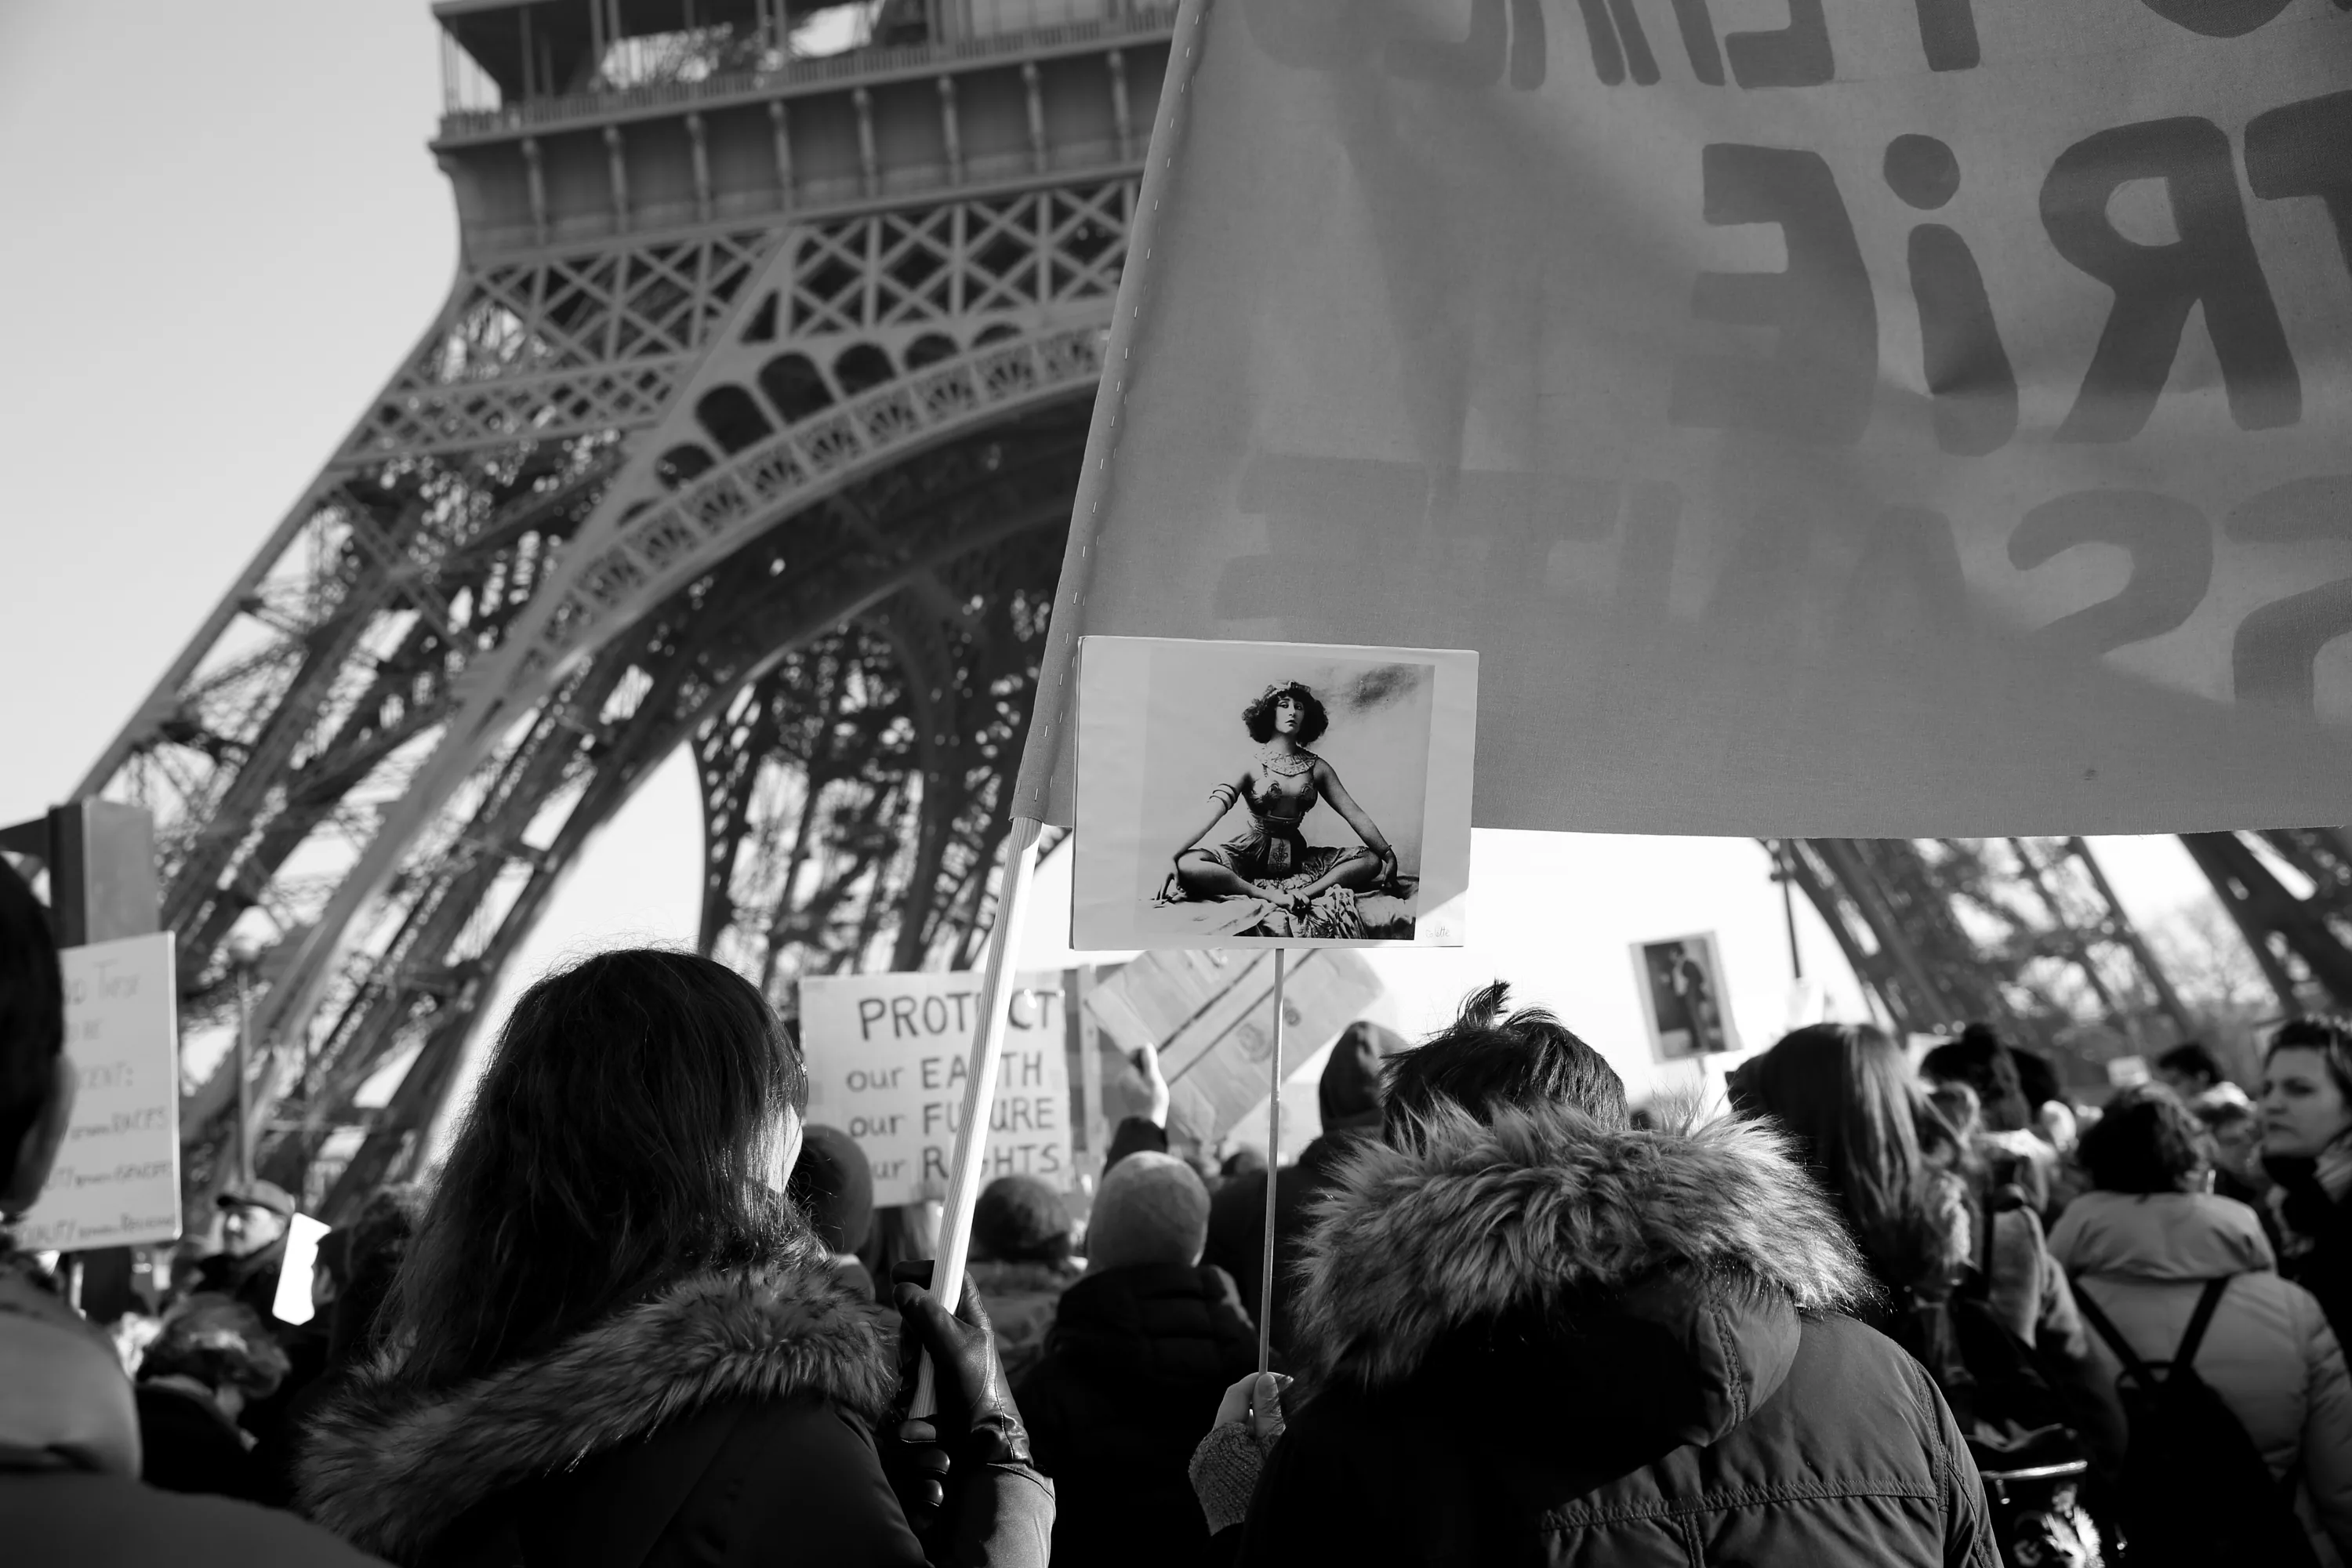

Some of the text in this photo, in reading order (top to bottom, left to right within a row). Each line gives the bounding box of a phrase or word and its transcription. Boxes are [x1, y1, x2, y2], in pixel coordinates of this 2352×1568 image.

[1425, 926, 1450, 938] Colette
[858, 989, 1058, 1041] PROTCT
[845, 1051, 1043, 1093] our EATH
[849, 1097, 1056, 1138] our FUURE
[871, 1142, 1060, 1182] ur RHTS
